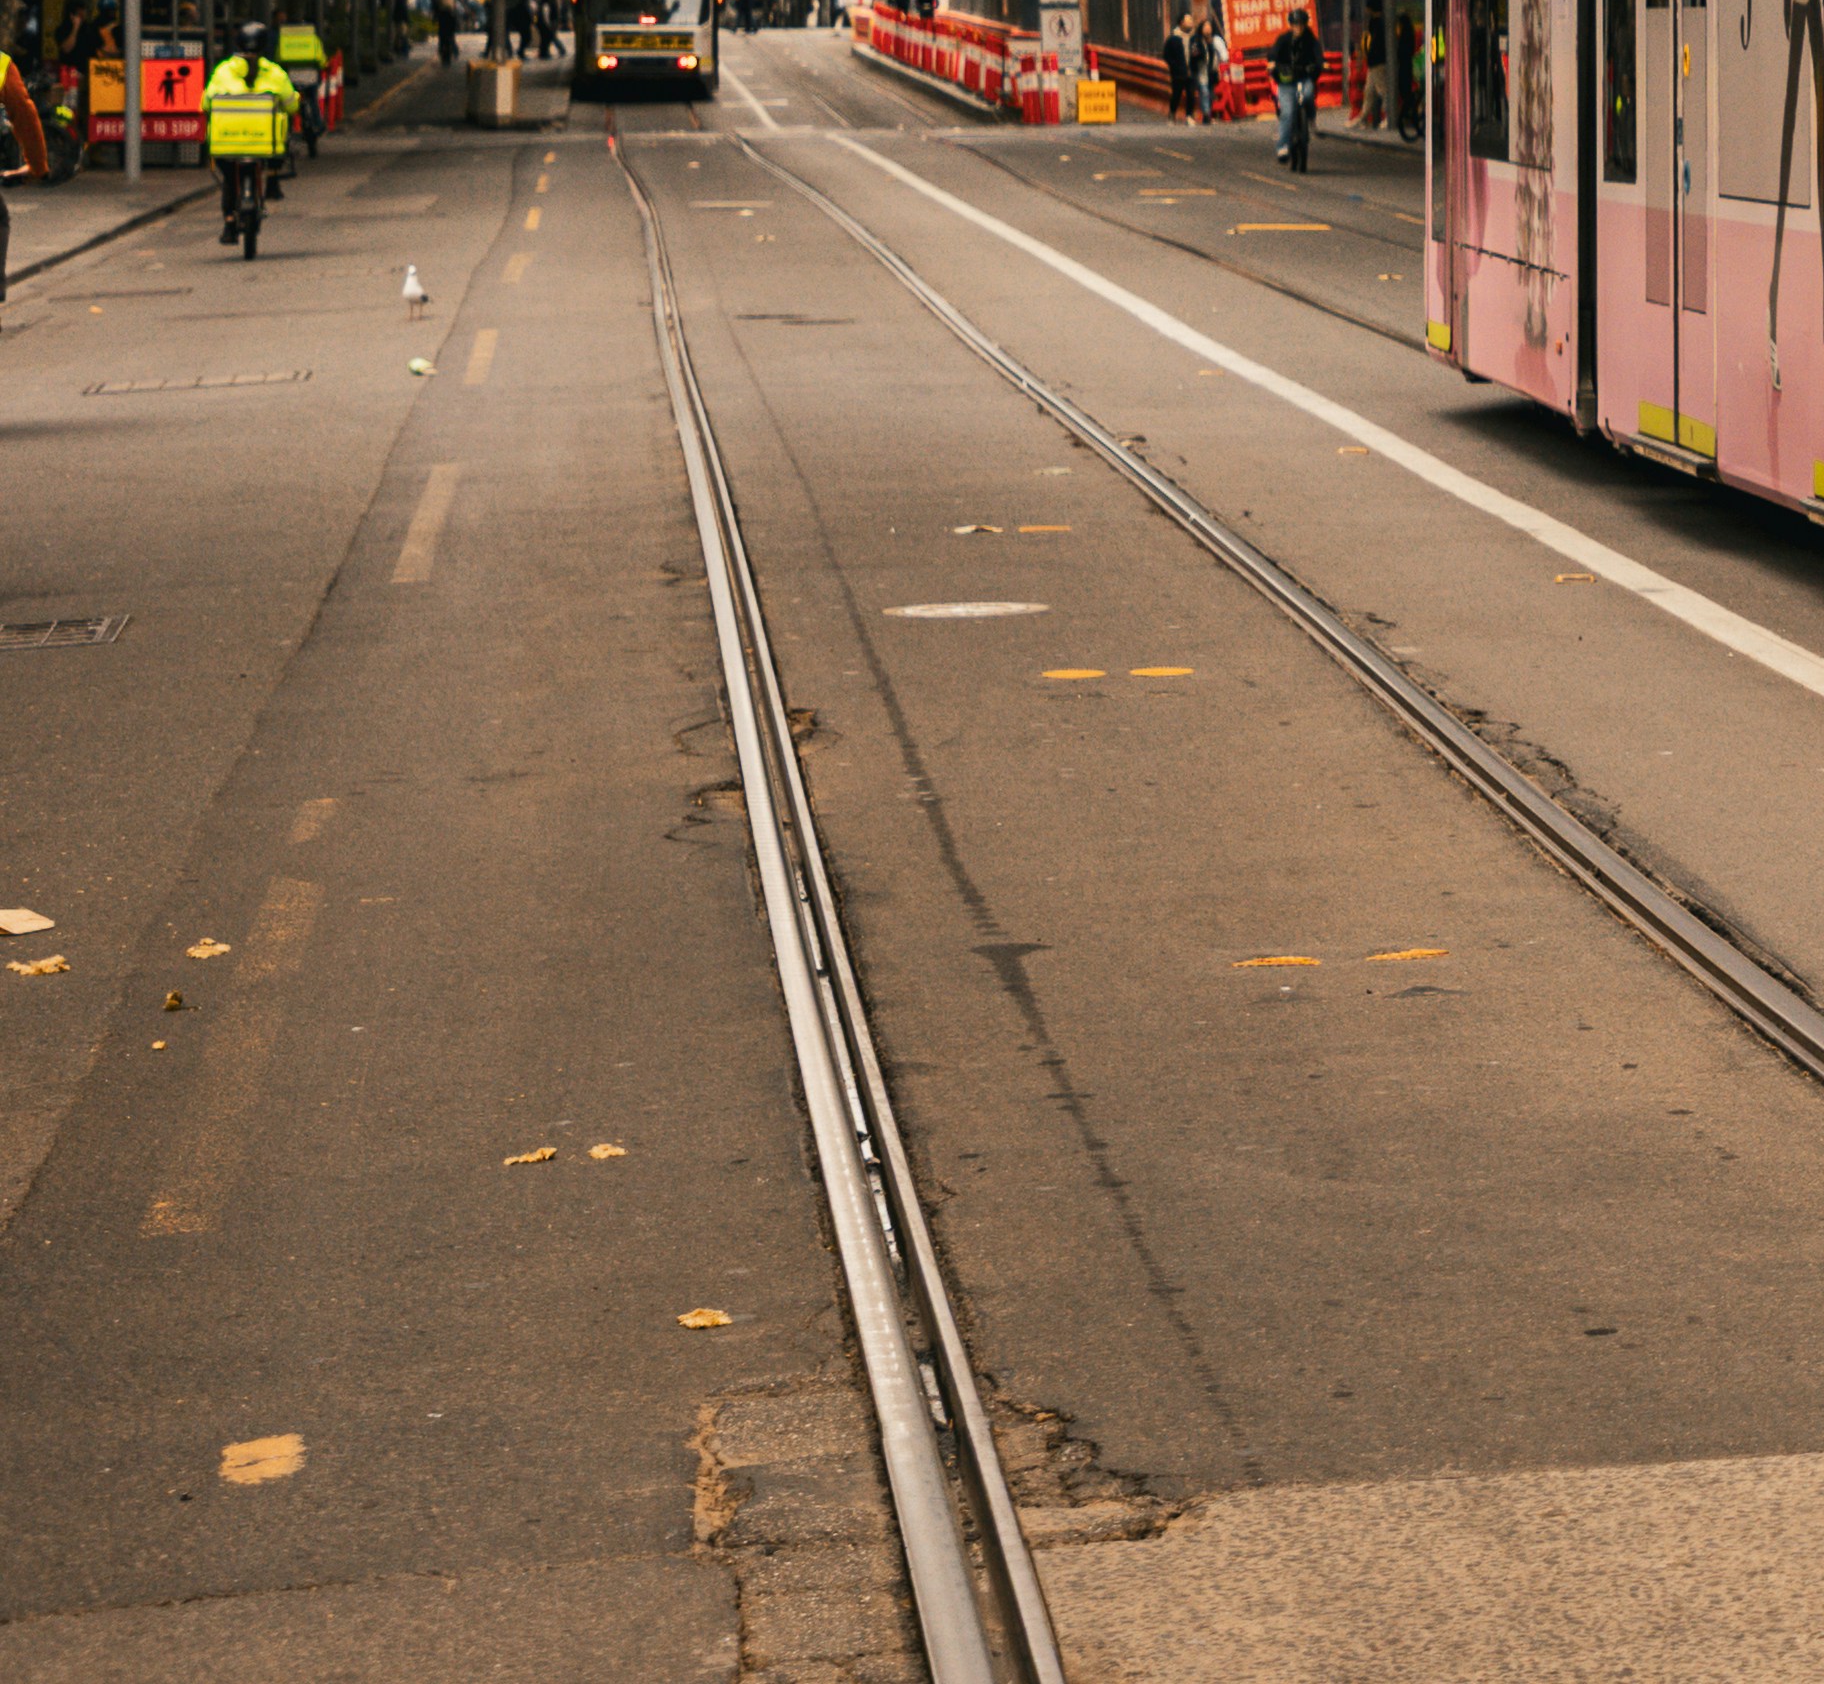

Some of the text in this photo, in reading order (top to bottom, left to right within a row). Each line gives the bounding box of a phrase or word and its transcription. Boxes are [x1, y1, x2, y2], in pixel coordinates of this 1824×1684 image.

[1233, 14, 1282, 35] NOT IN
[153, 121, 166, 135] TO
[172, 120, 199, 136] STOP
